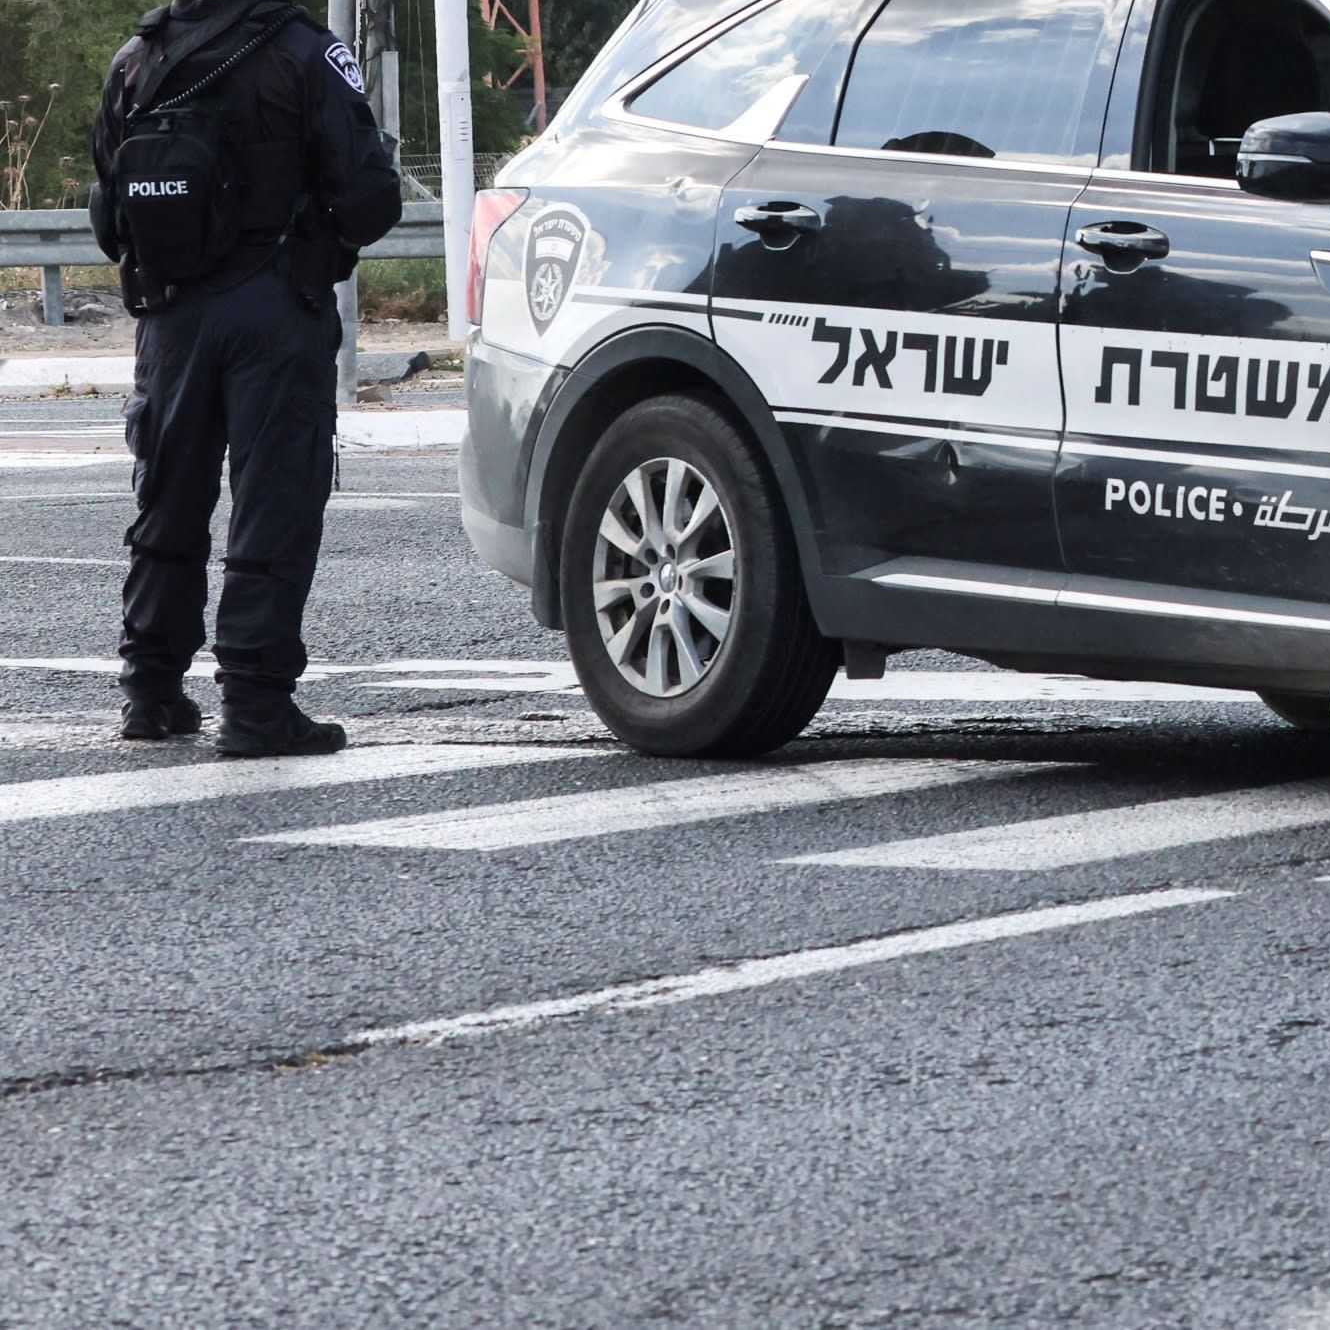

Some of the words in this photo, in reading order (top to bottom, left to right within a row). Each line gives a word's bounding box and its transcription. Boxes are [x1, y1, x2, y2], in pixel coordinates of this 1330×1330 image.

[129, 181, 188, 196] POLICE
[811, 317, 1009, 396] ישראל
[1105, 478, 1227, 522] POLICE
